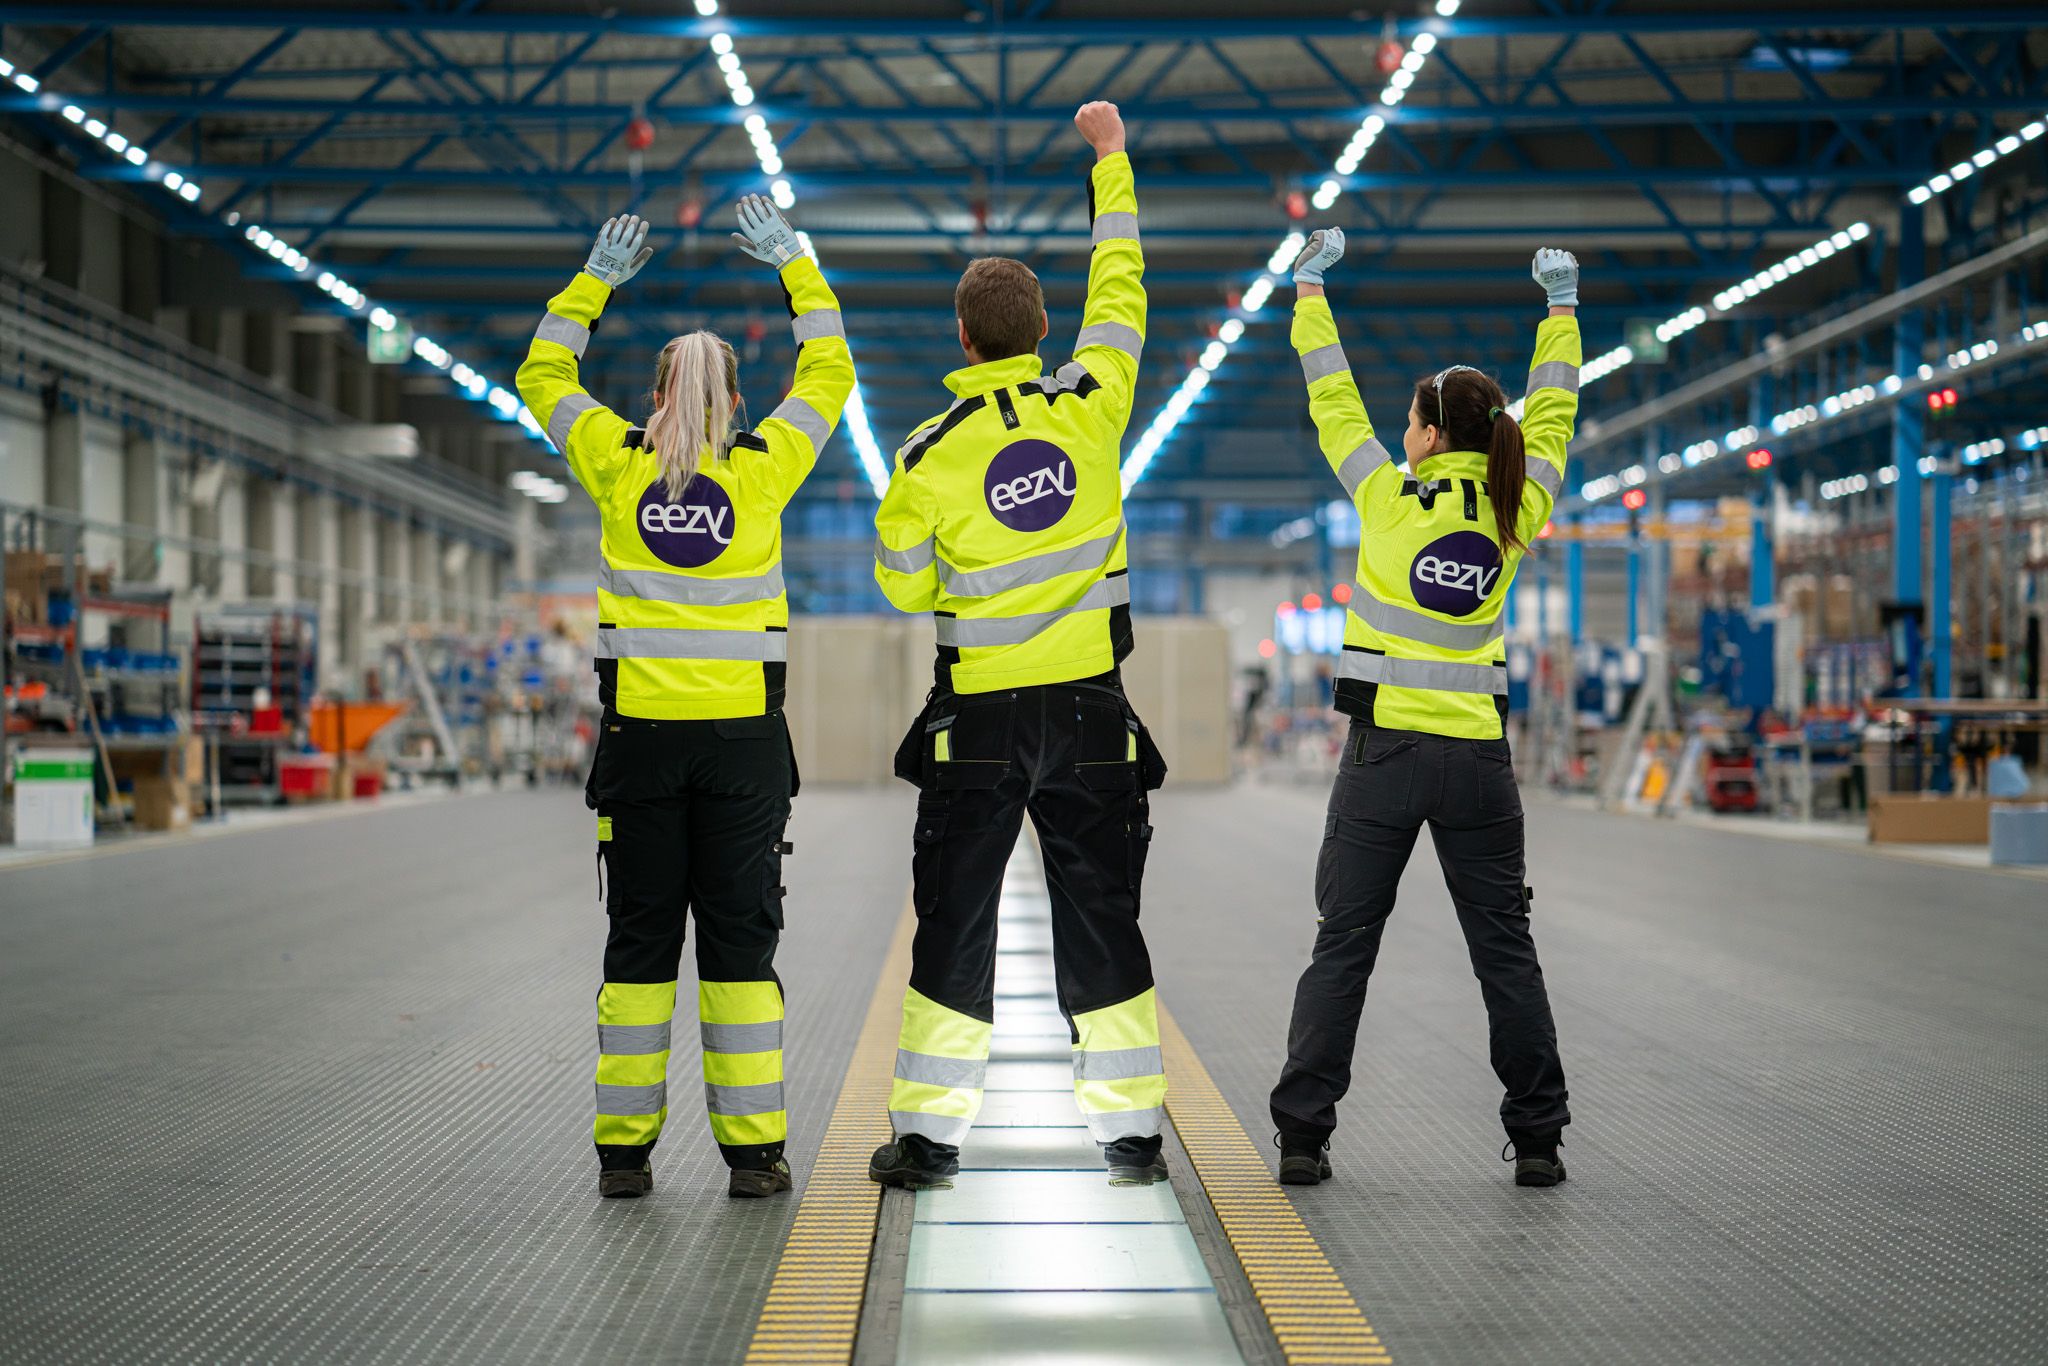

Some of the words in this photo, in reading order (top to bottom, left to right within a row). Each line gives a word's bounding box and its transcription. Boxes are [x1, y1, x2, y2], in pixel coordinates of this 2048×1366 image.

[991, 460, 1077, 512] eezy
[641, 503, 733, 545] eezy
[1415, 555, 1499, 601] eezy
